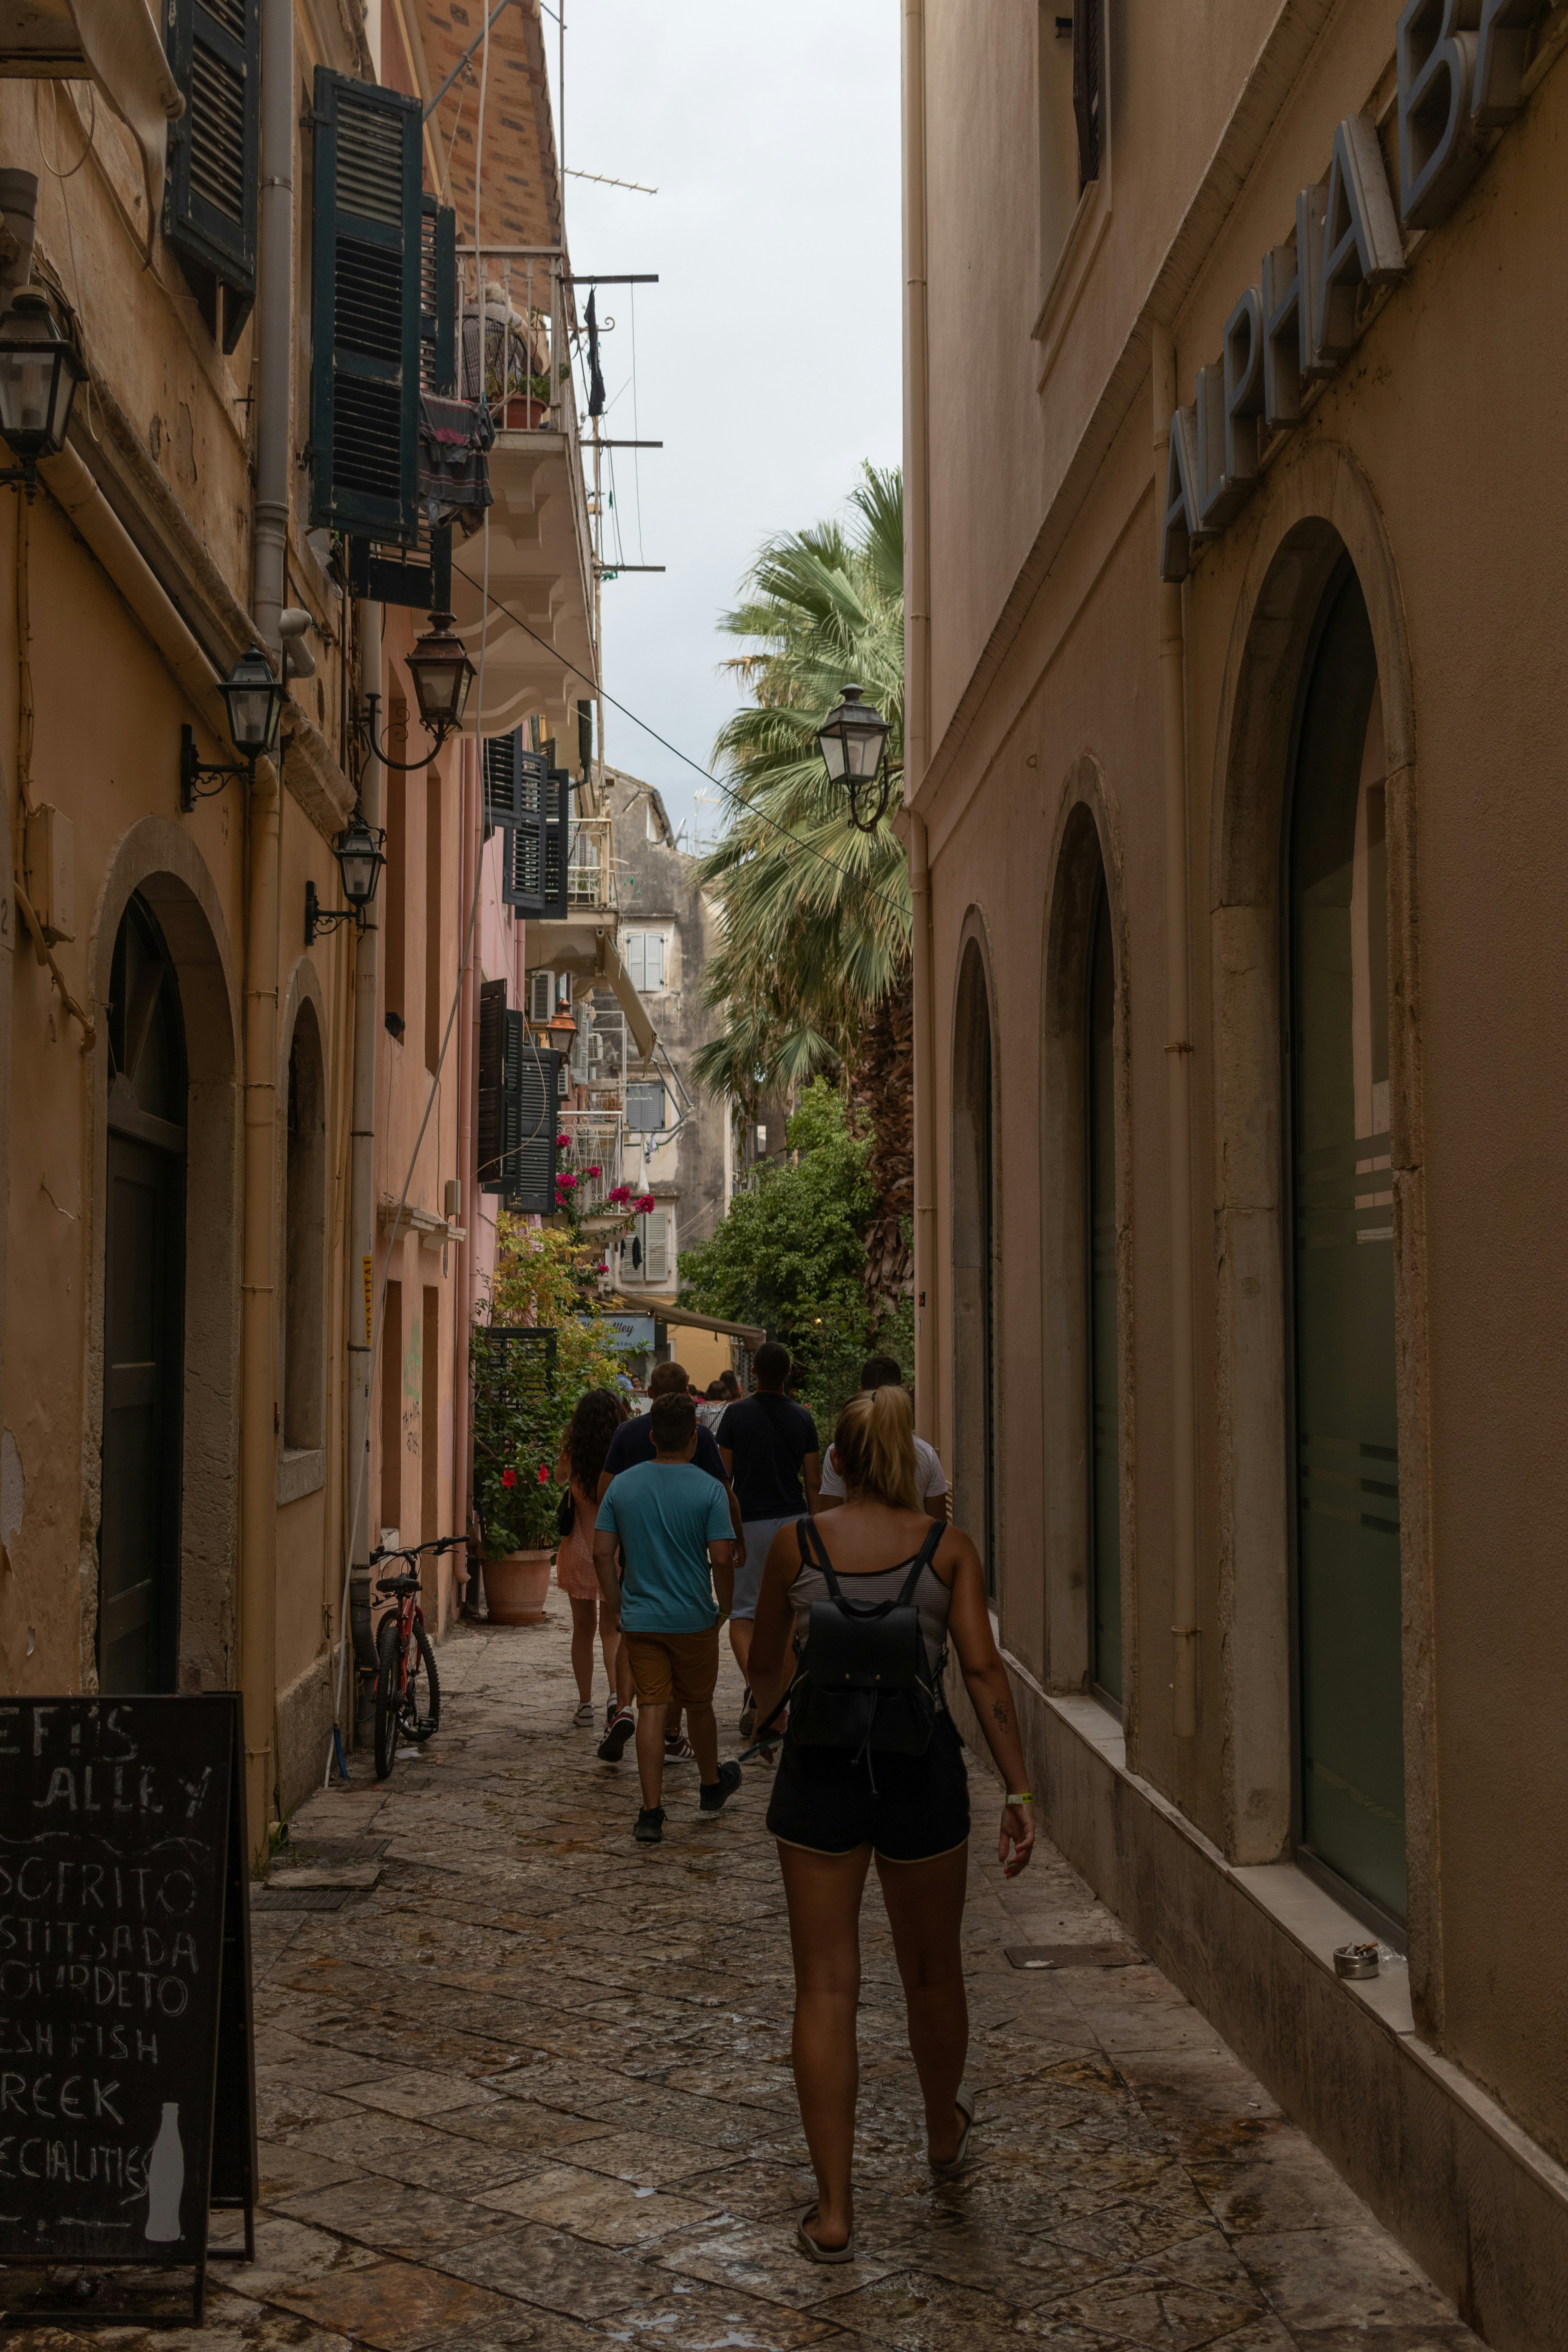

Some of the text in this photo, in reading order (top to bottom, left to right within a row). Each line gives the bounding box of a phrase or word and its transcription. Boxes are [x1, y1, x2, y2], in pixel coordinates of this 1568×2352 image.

[1160, 113, 1405, 583] ALPHA
[32, 1766, 212, 1818] ALLEY
[71, 2022, 158, 2063] FISH
[2, 2071, 125, 2125] REEK
